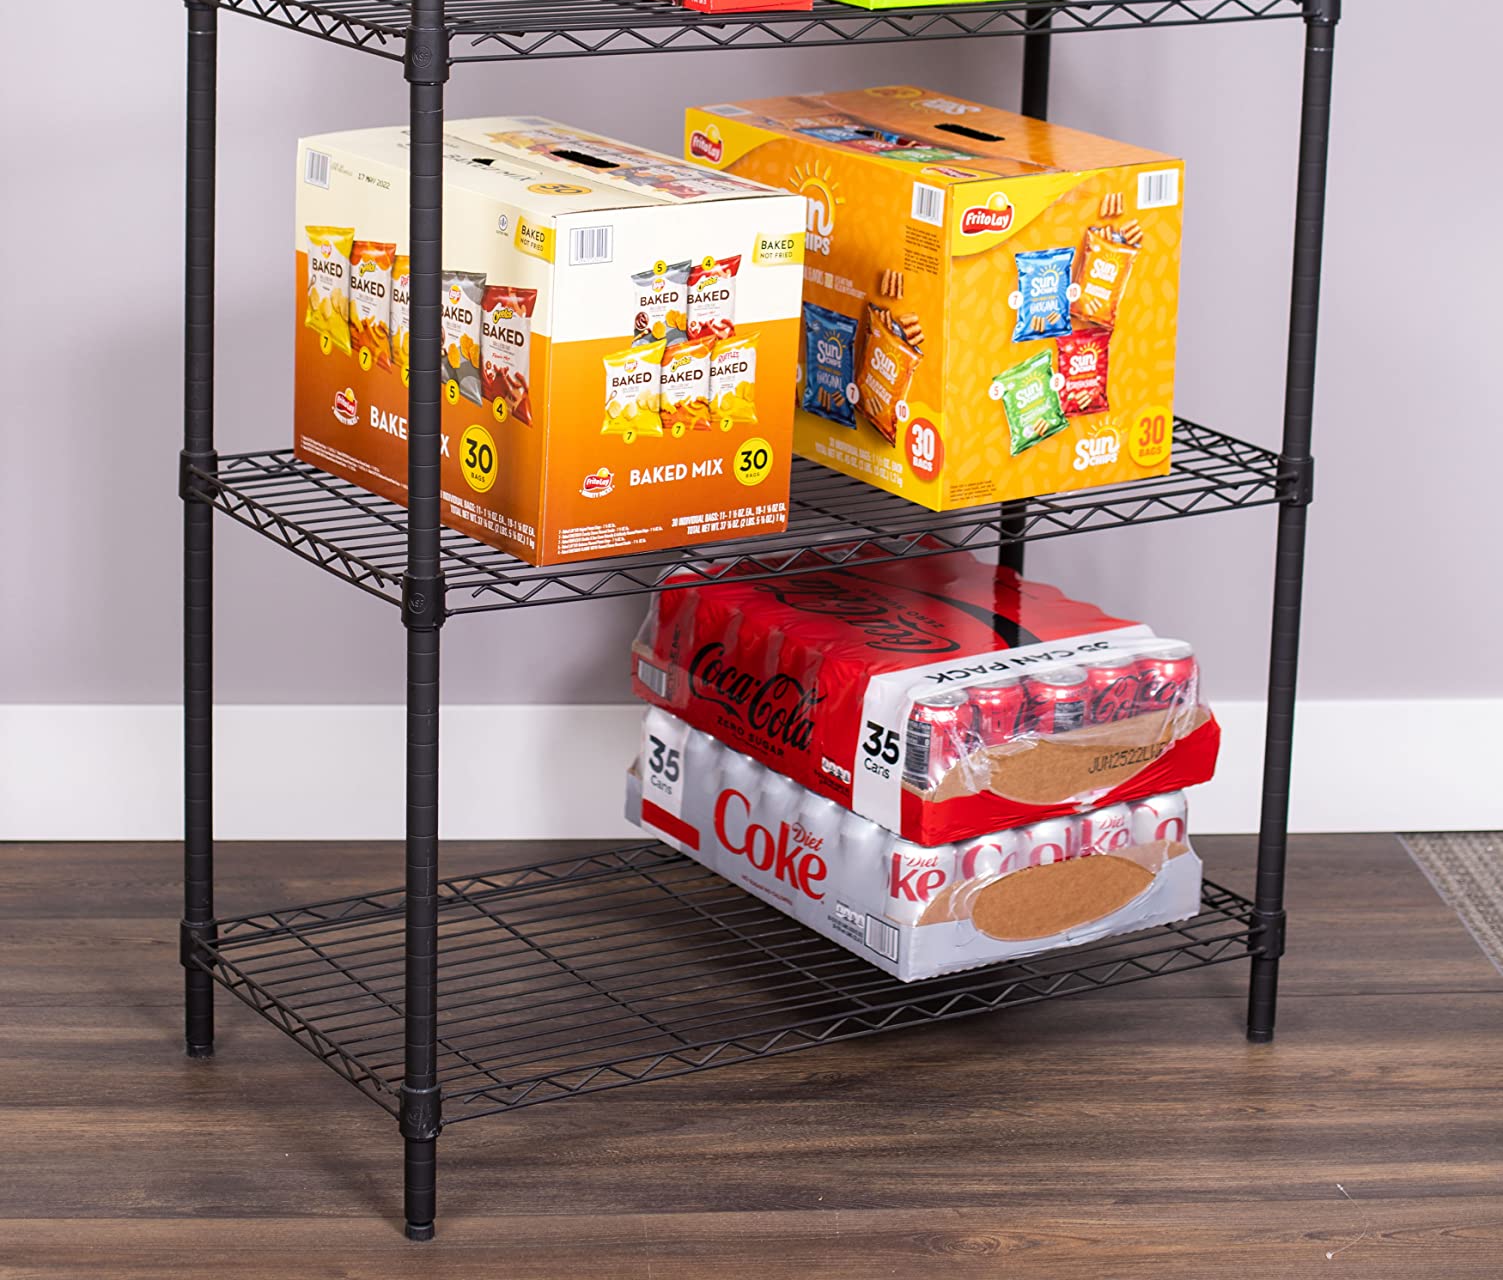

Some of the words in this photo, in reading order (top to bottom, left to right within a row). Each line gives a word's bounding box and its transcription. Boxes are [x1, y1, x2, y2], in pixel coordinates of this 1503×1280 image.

[376, 178, 391, 190] 2022
[520, 224, 546, 244] BAKED
[519, 237, 530, 247] NOT
[530, 240, 545, 252] FRIED
[760, 239, 795, 251] BAKED
[705, 259, 711, 267] 4
[759, 252, 773, 260] NOT
[774, 251, 793, 259] FRIED
[312, 257, 343, 278] BAKED
[656, 263, 663, 273] 5
[350, 276, 386, 298] BAKED
[1030, 275, 1059, 297] Sun
[1069, 287, 1078, 298] 10
[639, 291, 679, 307] BAKED
[686, 289, 730, 304] BAKED
[441, 306, 473, 325] AKED
[323, 336, 329, 349] 7
[482, 323, 525, 347] BAKED
[362, 353, 369, 365] 7
[816, 340, 844, 365] Sun
[709, 361, 748, 377] BAKED
[870, 347, 898, 376] Sun
[1068, 353, 1098, 376] Sun
[611, 371, 653, 388] BAKED
[660, 369, 704, 385] BAKED
[449, 386, 456, 398] 5
[495, 403, 503, 417] 4
[898, 404, 907, 418] 10
[370, 405, 408, 441] BAKE
[675, 425, 682, 435] 7
[723, 419, 730, 429] 7
[1138, 415, 1165, 447] 30
[626, 431, 633, 440] 7
[911, 423, 935, 461] 30
[465, 437, 493, 474] 30
[1072, 434, 1120, 471] Sun
[1089, 453, 1118, 466] CHIPS
[1138, 446, 1162, 457] BAGS
[739, 448, 768, 472] 30
[912, 456, 933, 472] BAGS
[470, 471, 486, 483] BAGS
[629, 463, 688, 487] BAKED
[691, 458, 724, 478] MIX
[745, 471, 761, 479] BAGS
[1076, 641, 1110, 653] 35
[1010, 649, 1074, 667] CAN
[925, 661, 1014, 685] PACK
[717, 715, 746, 737] ZERO
[749, 732, 785, 756] SUGAR
[862, 721, 900, 766] 35
[648, 734, 681, 783] 35
[863, 758, 891, 780] Cans
[650, 773, 673, 796] Cans
[1098, 816, 1127, 831] Diet
[792, 821, 825, 851] Diet
[713, 788, 828, 901] Coke
[902, 853, 939, 868] Diet
